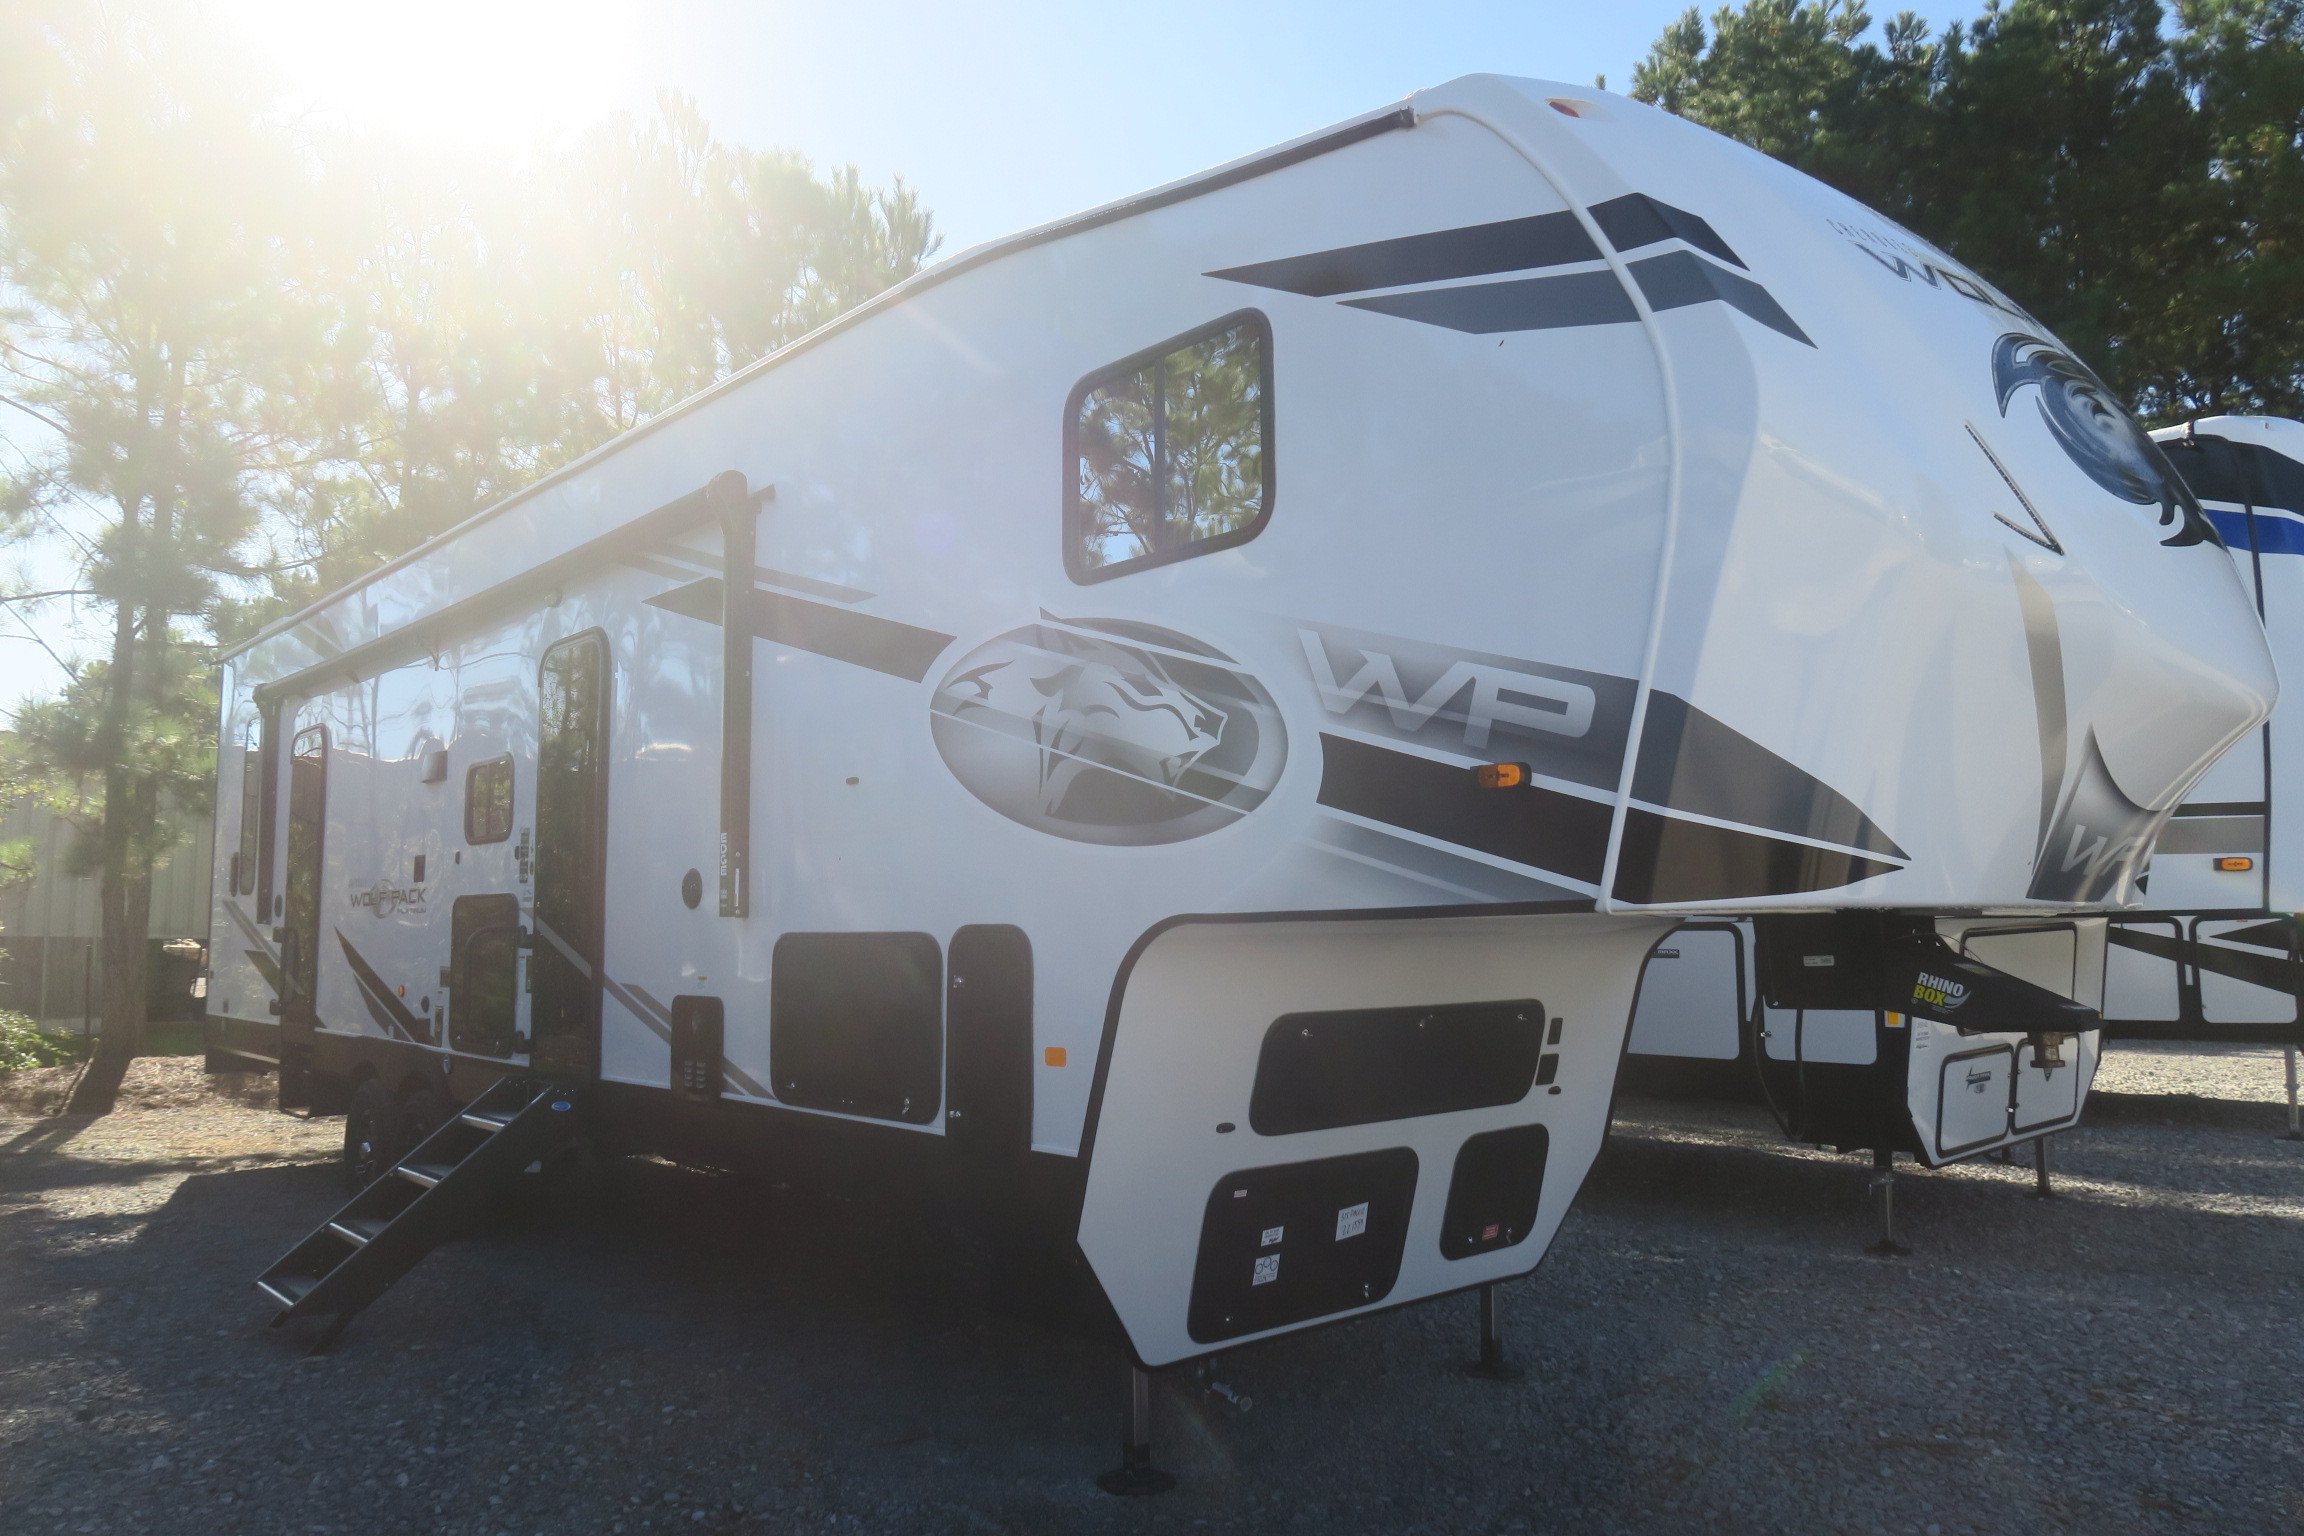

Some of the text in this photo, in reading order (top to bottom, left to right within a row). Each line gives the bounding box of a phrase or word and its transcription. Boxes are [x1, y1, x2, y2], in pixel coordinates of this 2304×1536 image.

[1297, 626, 1596, 750] WP
[391, 888, 427, 904] PACK
[1913, 984, 1947, 1007] BOX
[1917, 971, 1964, 997] RHINO
